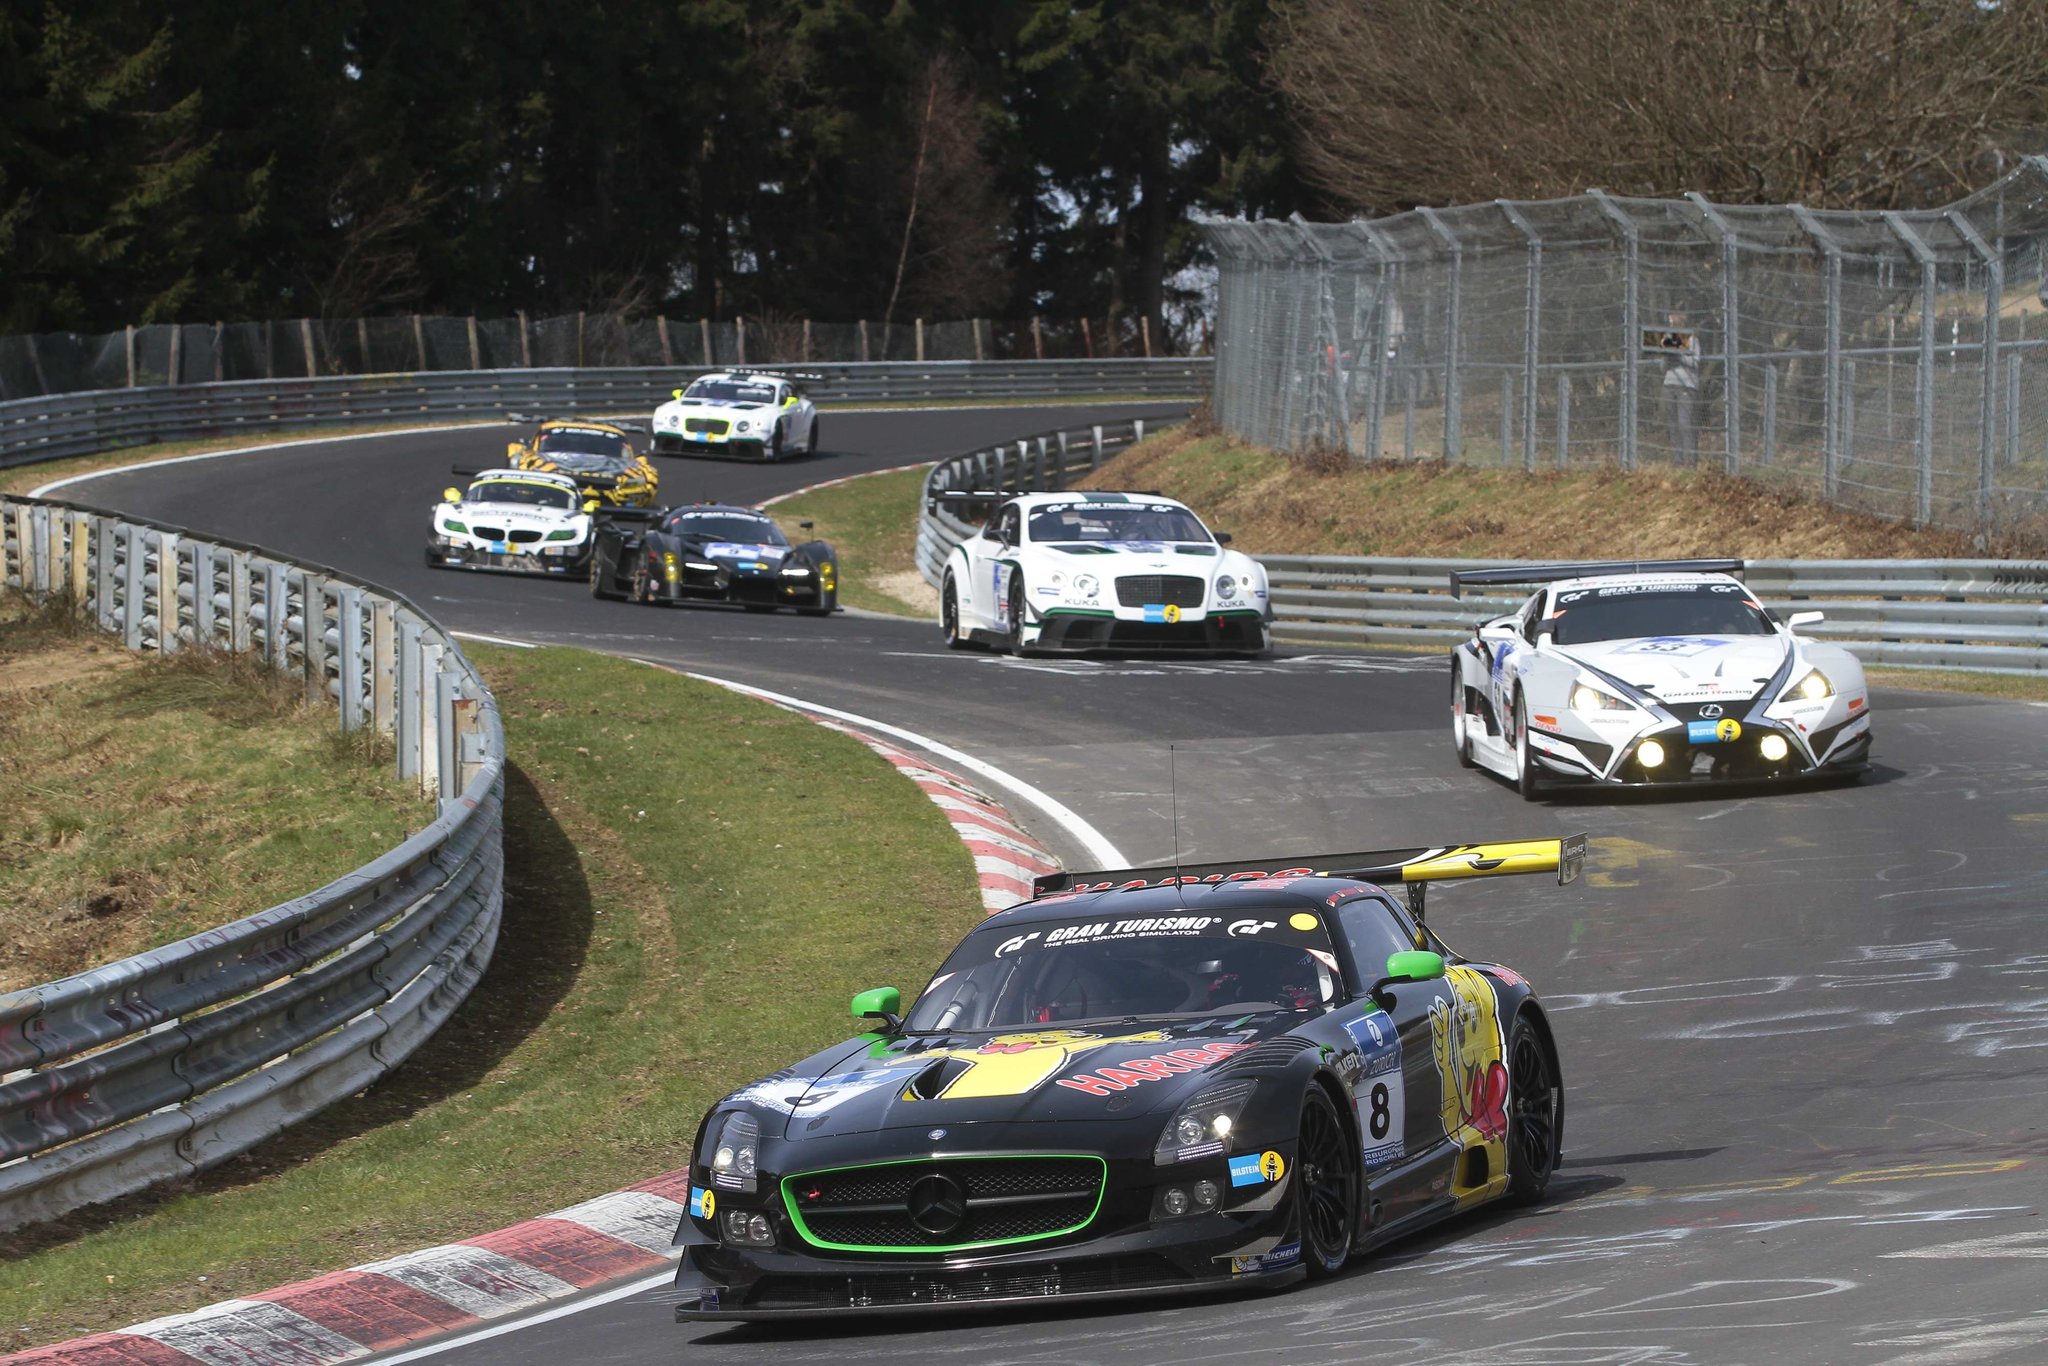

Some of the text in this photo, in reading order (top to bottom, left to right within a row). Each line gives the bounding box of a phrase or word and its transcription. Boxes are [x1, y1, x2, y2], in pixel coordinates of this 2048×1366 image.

[1064, 598, 1100, 606] KUKA
[1217, 600, 1246, 608] KUKA
[1045, 922, 1110, 943] GRAN
[1043, 940, 1062, 948] THE
[1064, 937, 1090, 945] REAL
[1092, 933, 1136, 941] DRIVING
[1369, 1051, 1397, 1075] ZURICH
[1369, 1082, 1390, 1140] 8
[1232, 1165, 1260, 1177] BILSTEIN
